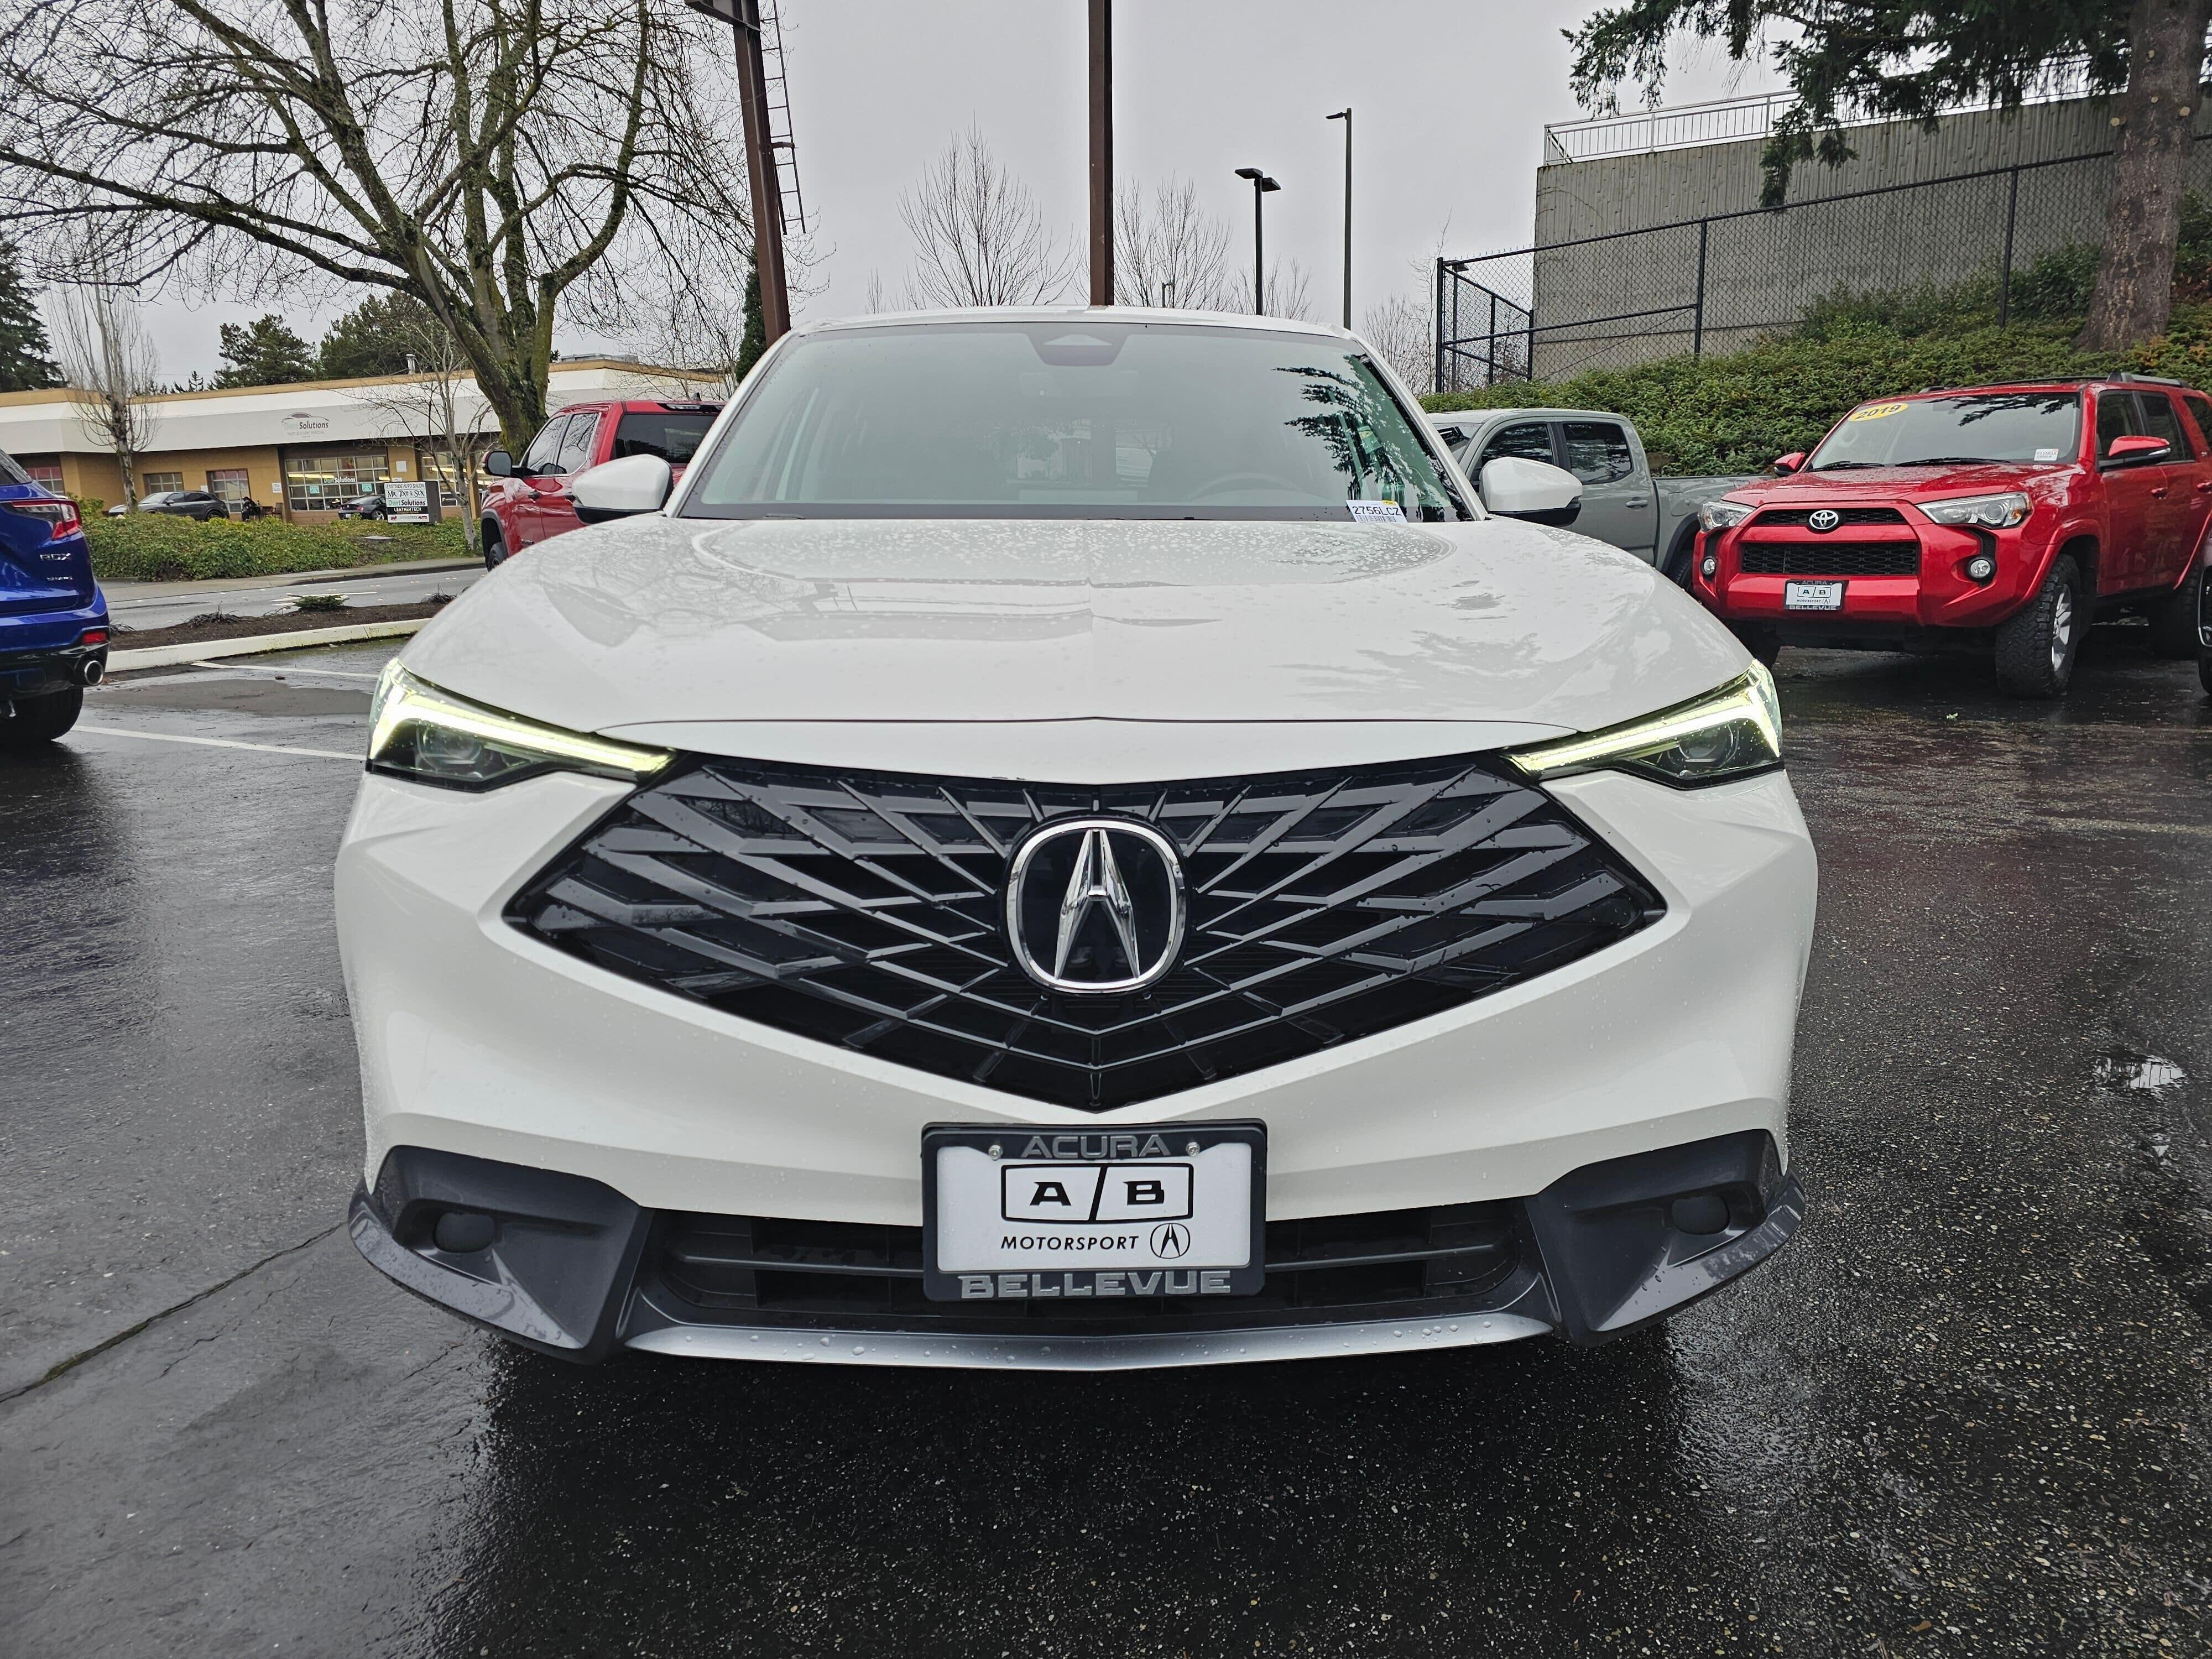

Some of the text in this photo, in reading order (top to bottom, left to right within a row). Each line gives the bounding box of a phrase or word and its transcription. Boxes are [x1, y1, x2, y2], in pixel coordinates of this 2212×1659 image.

[1855, 405, 1901, 419] 2019
[1352, 506, 1402, 516] 2756LCZ
[1020, 1134, 1171, 1159] ACURA
[1030, 1180, 1165, 1206] A B
[1001, 1235, 1139, 1250] MOTORSPORT
[957, 1271, 1231, 1299] BELLEVUE
